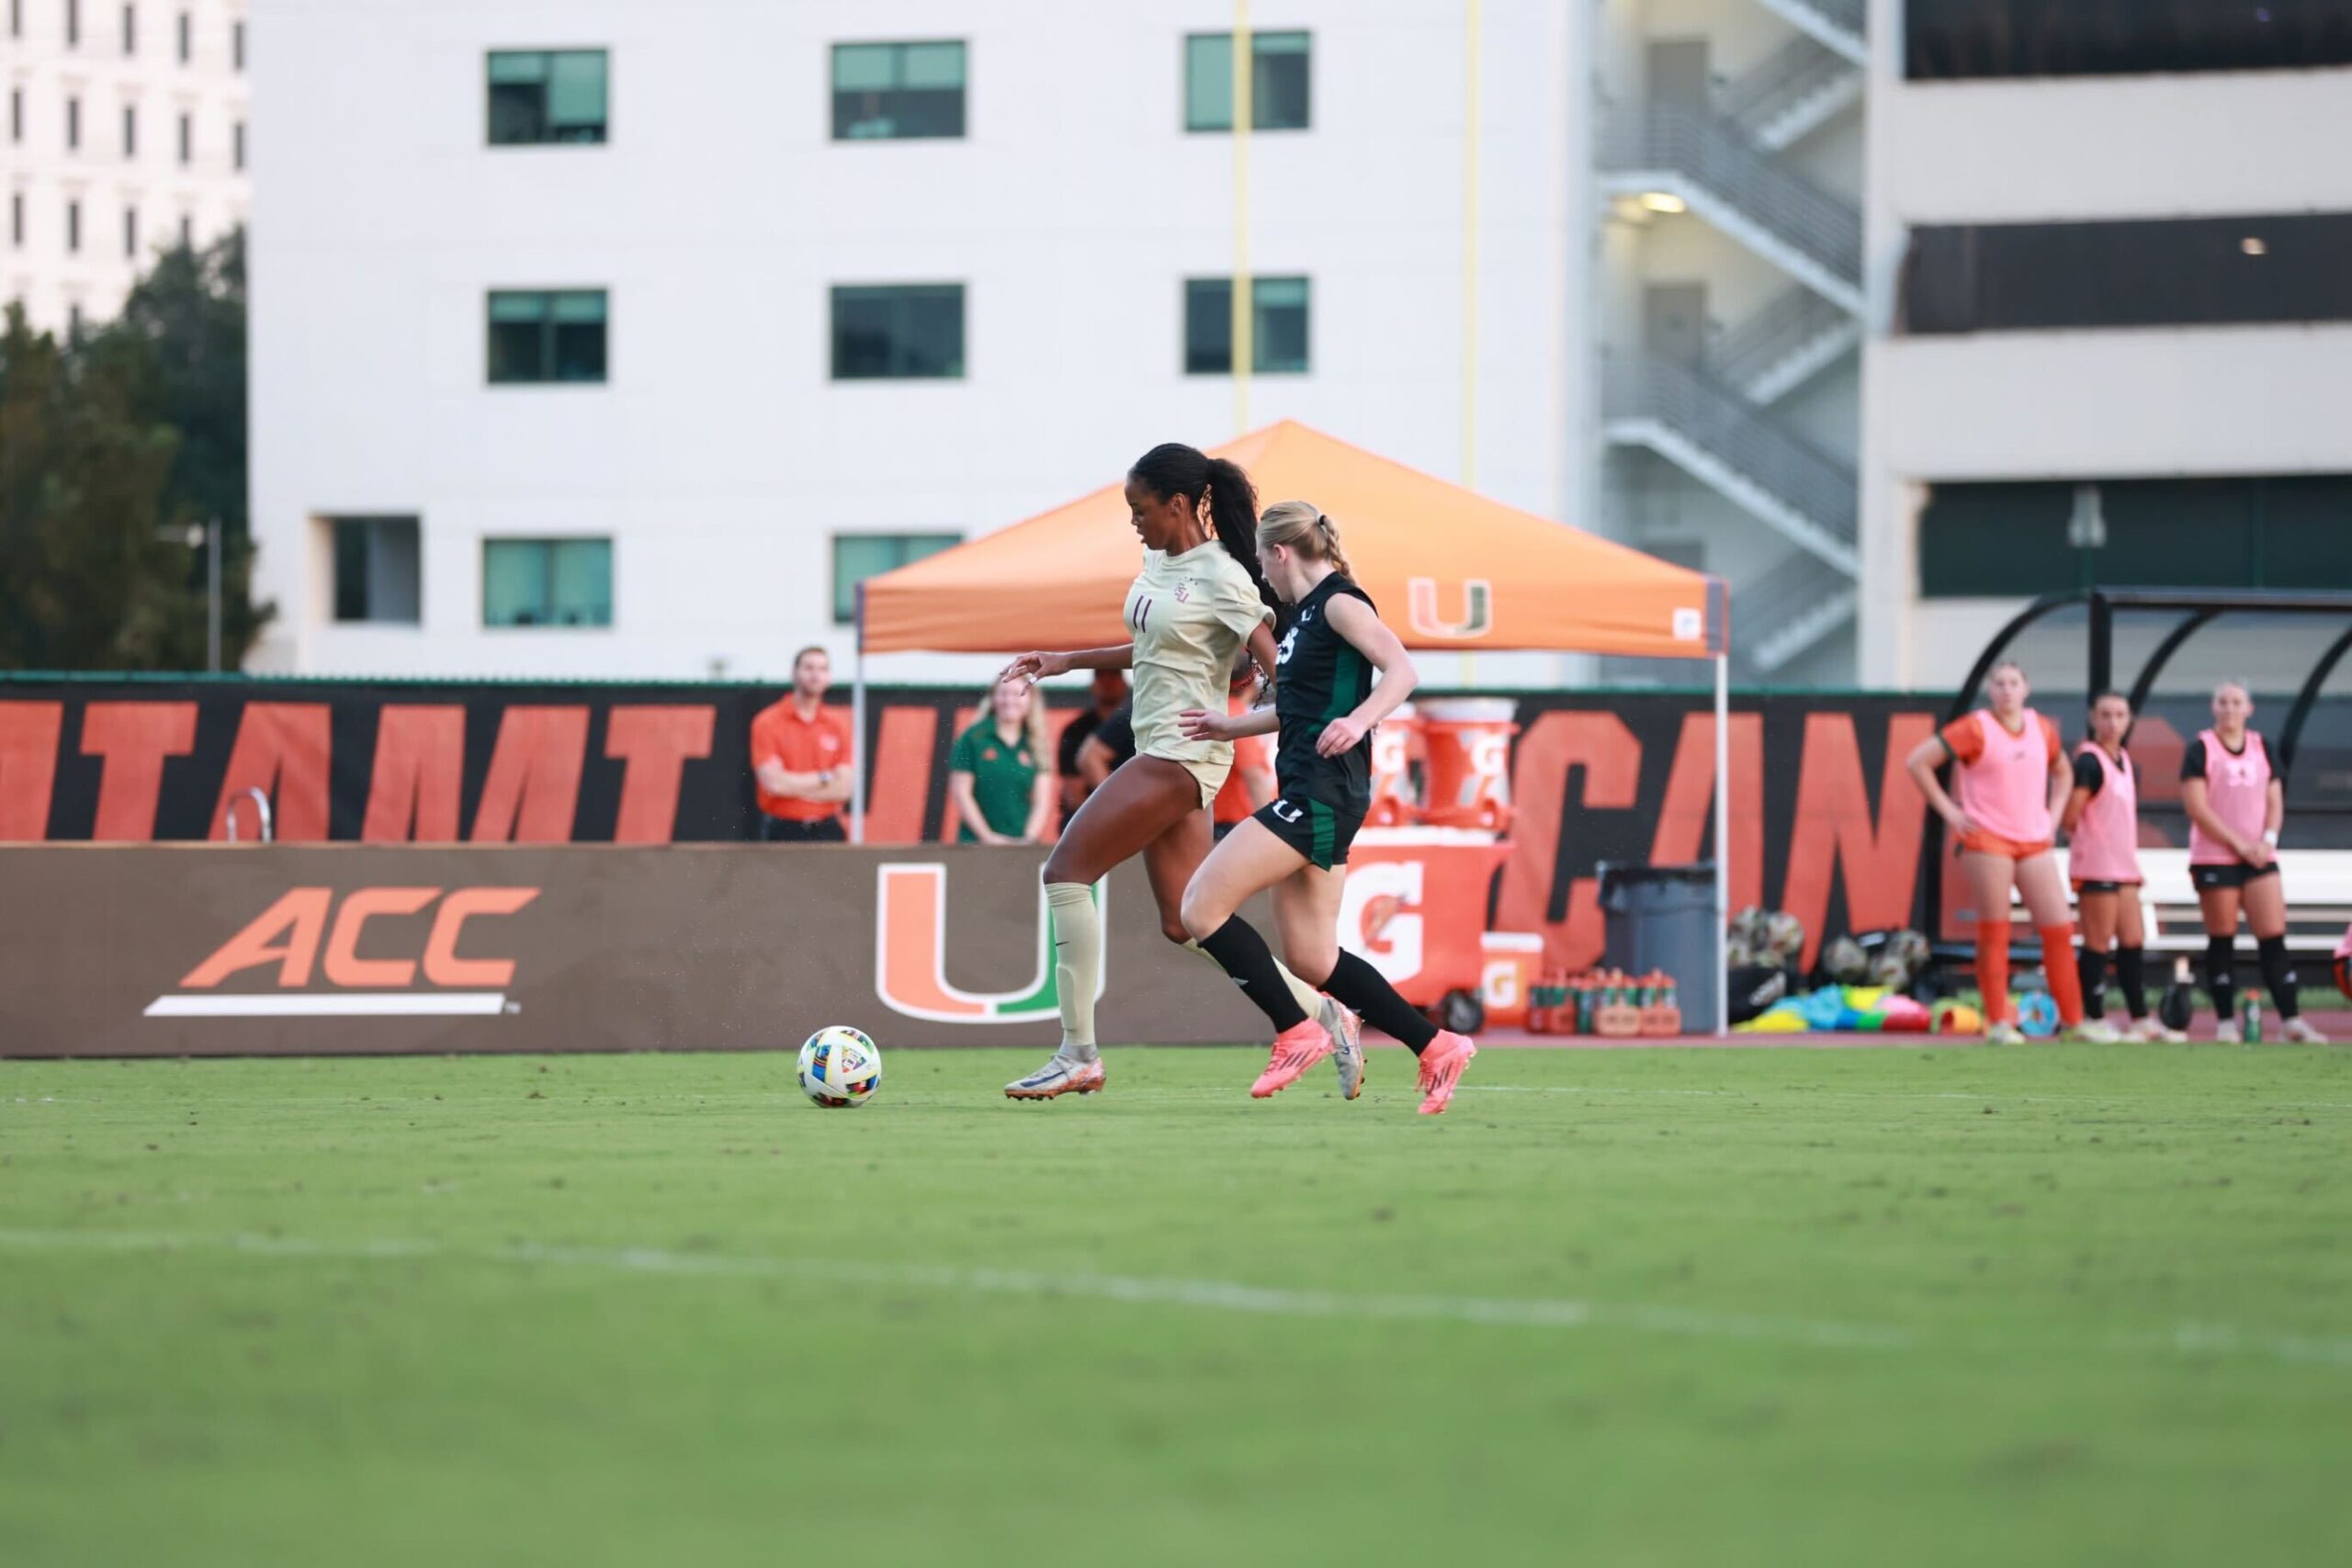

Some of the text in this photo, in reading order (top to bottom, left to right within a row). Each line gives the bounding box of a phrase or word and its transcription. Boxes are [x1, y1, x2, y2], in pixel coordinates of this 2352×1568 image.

[1133, 595, 1152, 633] 11
[1408, 576, 1492, 639] U
[178, 887, 541, 988] ACC
[876, 862, 1107, 1024] U
